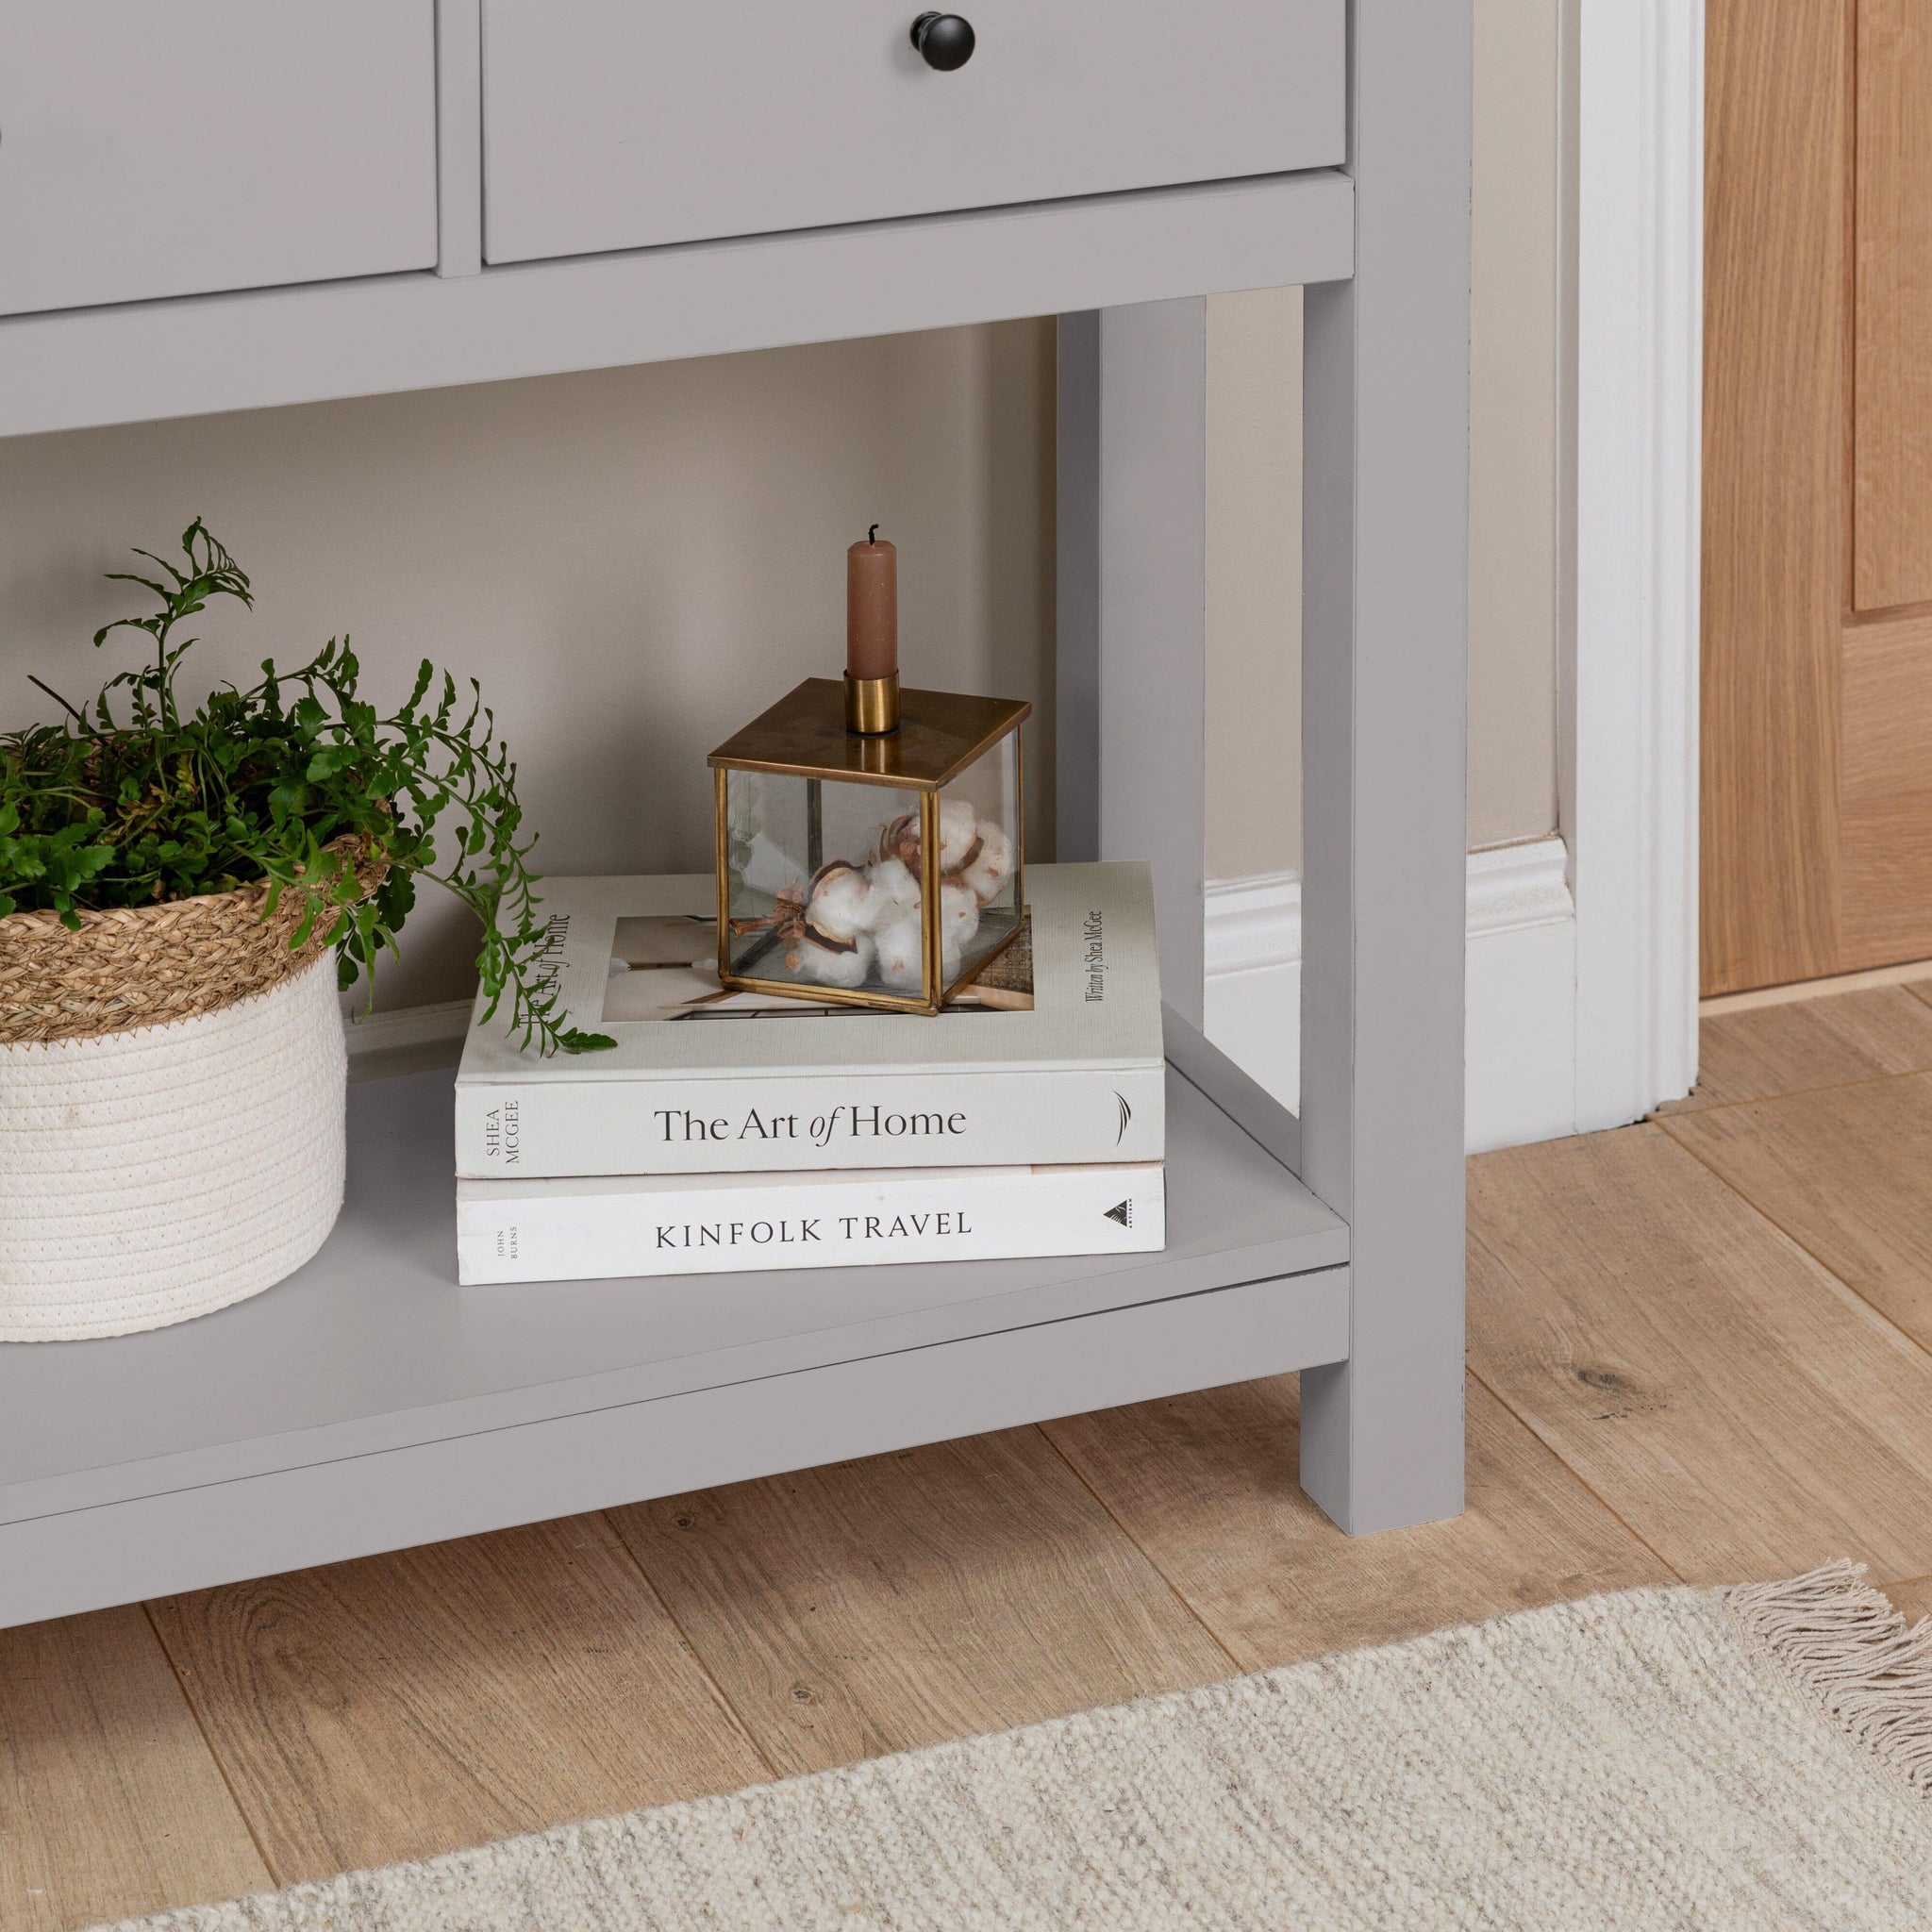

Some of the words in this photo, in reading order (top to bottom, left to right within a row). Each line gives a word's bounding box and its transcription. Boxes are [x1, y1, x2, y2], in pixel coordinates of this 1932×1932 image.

[1083, 911, 1103, 941] McGee
[1084, 942, 1104, 962] Shea
[1085, 963, 1109, 973] by
[1085, 974, 1104, 1002] Written
[486, 1108, 501, 1157] SHEA
[505, 1100, 520, 1164] MCGEE
[653, 1109, 730, 1141] The
[737, 1108, 799, 1140] Art
[809, 1106, 846, 1148] of
[849, 1105, 967, 1137] Home
[496, 1230, 506, 1257] JOHN
[509, 1225, 518, 1259] BURNS
[655, 1218, 822, 1249] KINFOLK
[838, 1211, 973, 1240] TRAVEL
